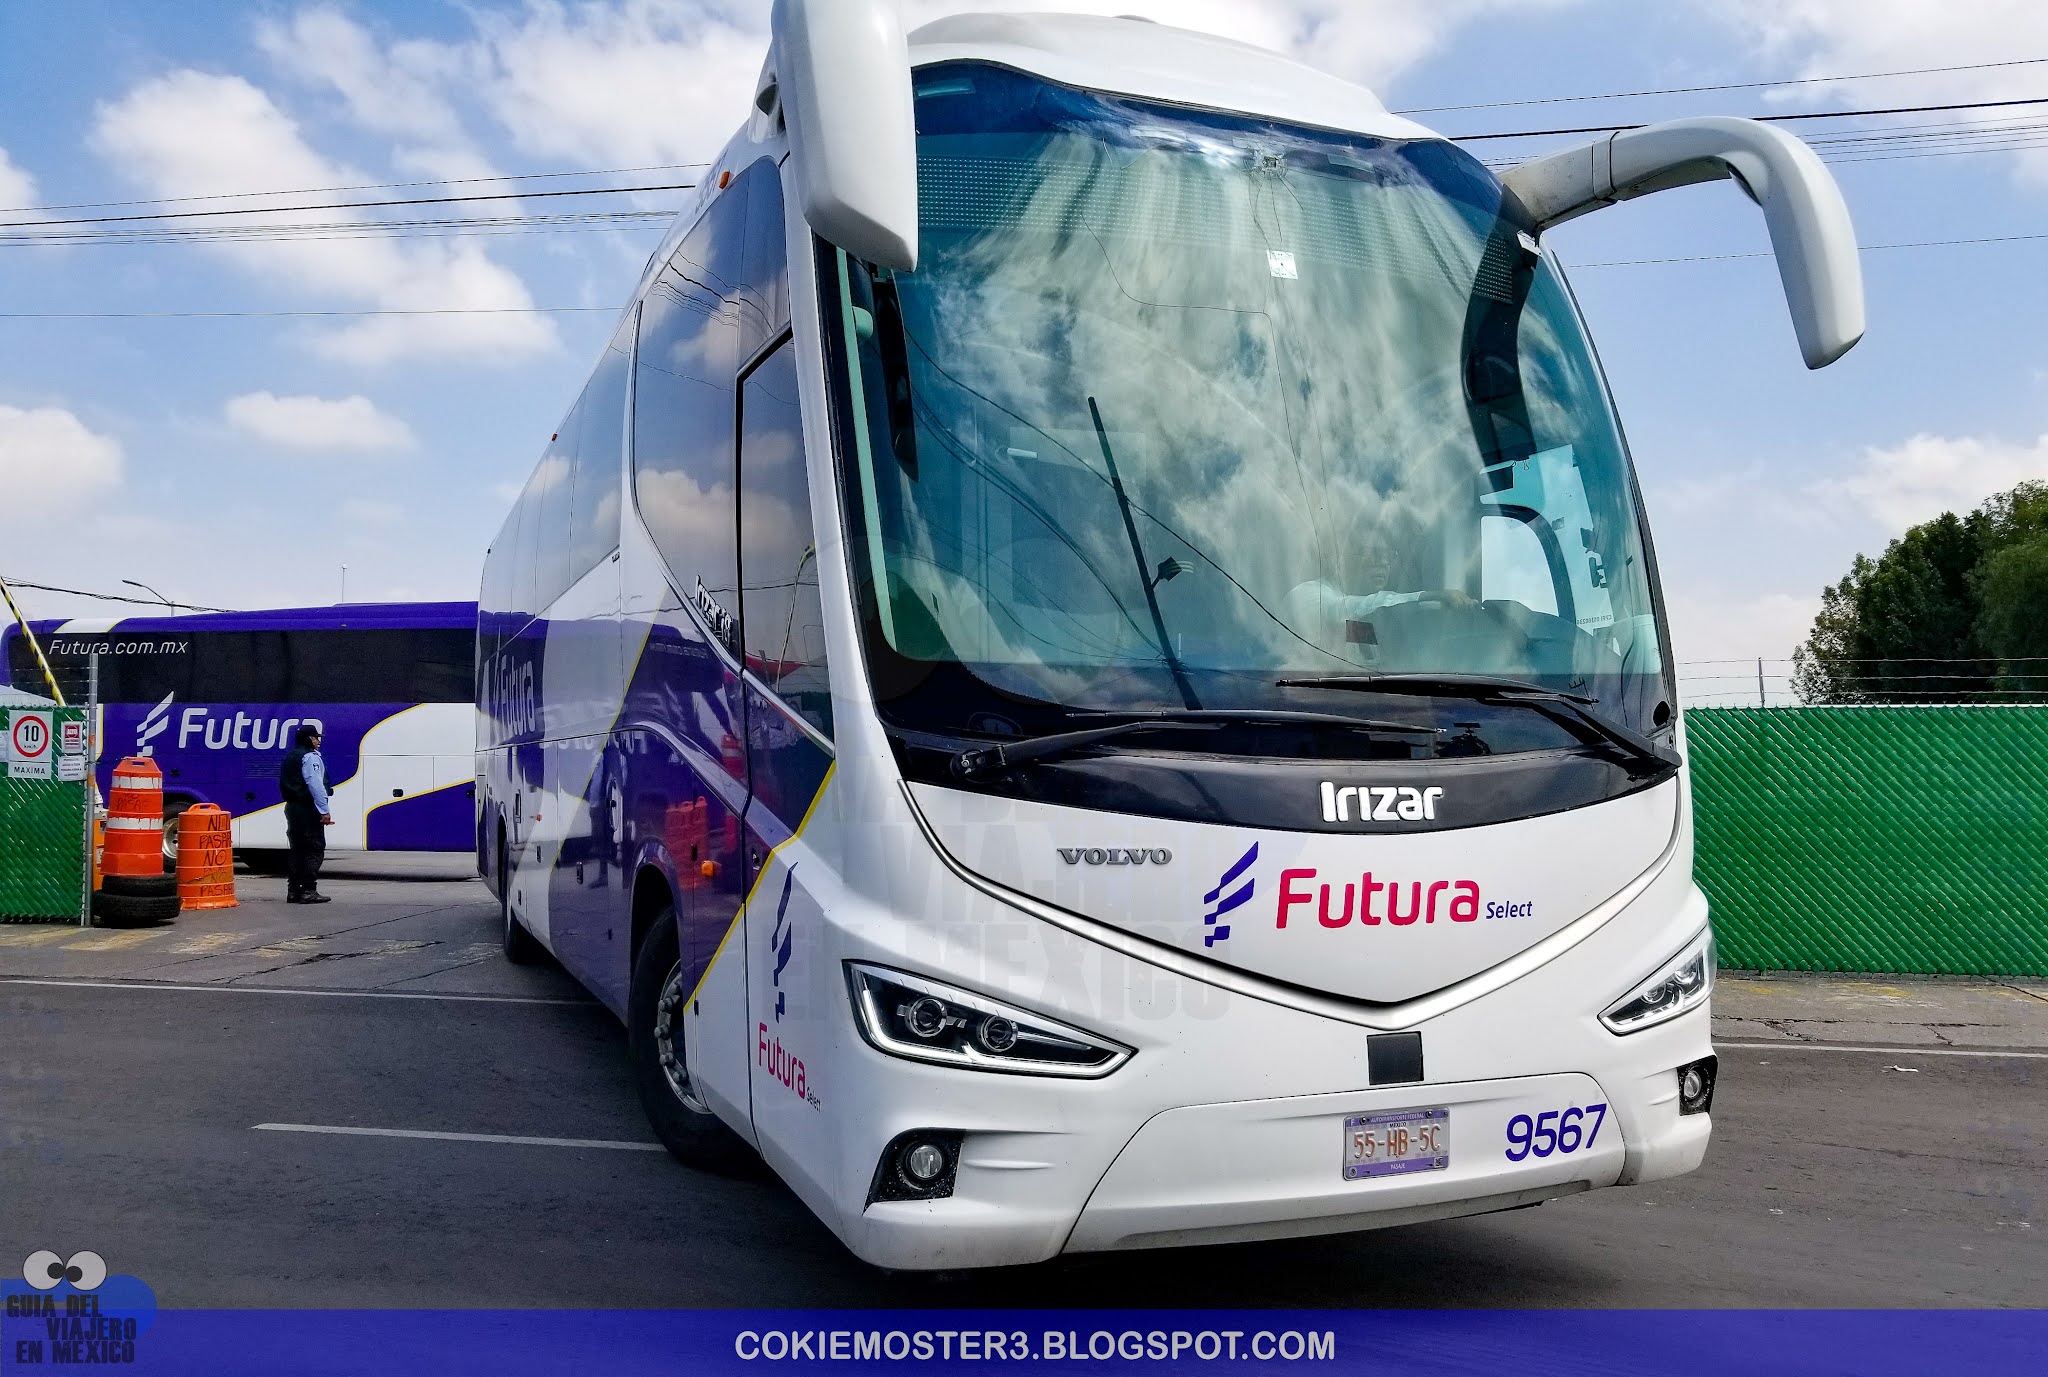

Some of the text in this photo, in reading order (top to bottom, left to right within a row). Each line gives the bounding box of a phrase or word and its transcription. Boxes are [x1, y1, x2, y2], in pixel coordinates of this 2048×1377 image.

[48, 639, 189, 656] Futura.com.mx
[501, 654, 536, 740] Futura
[24, 725, 39, 742] 10
[14, 766, 46, 775] MAXIMA
[1320, 781, 1443, 822] Irizar
[203, 850, 227, 866] NO
[1057, 847, 1172, 866] VOLVO
[1276, 868, 1533, 930] Futura Select
[759, 1022, 821, 1113] Futura Select
[1354, 1124, 1441, 1158] 55-HB-5C
[1505, 1103, 1607, 1161] 9567
